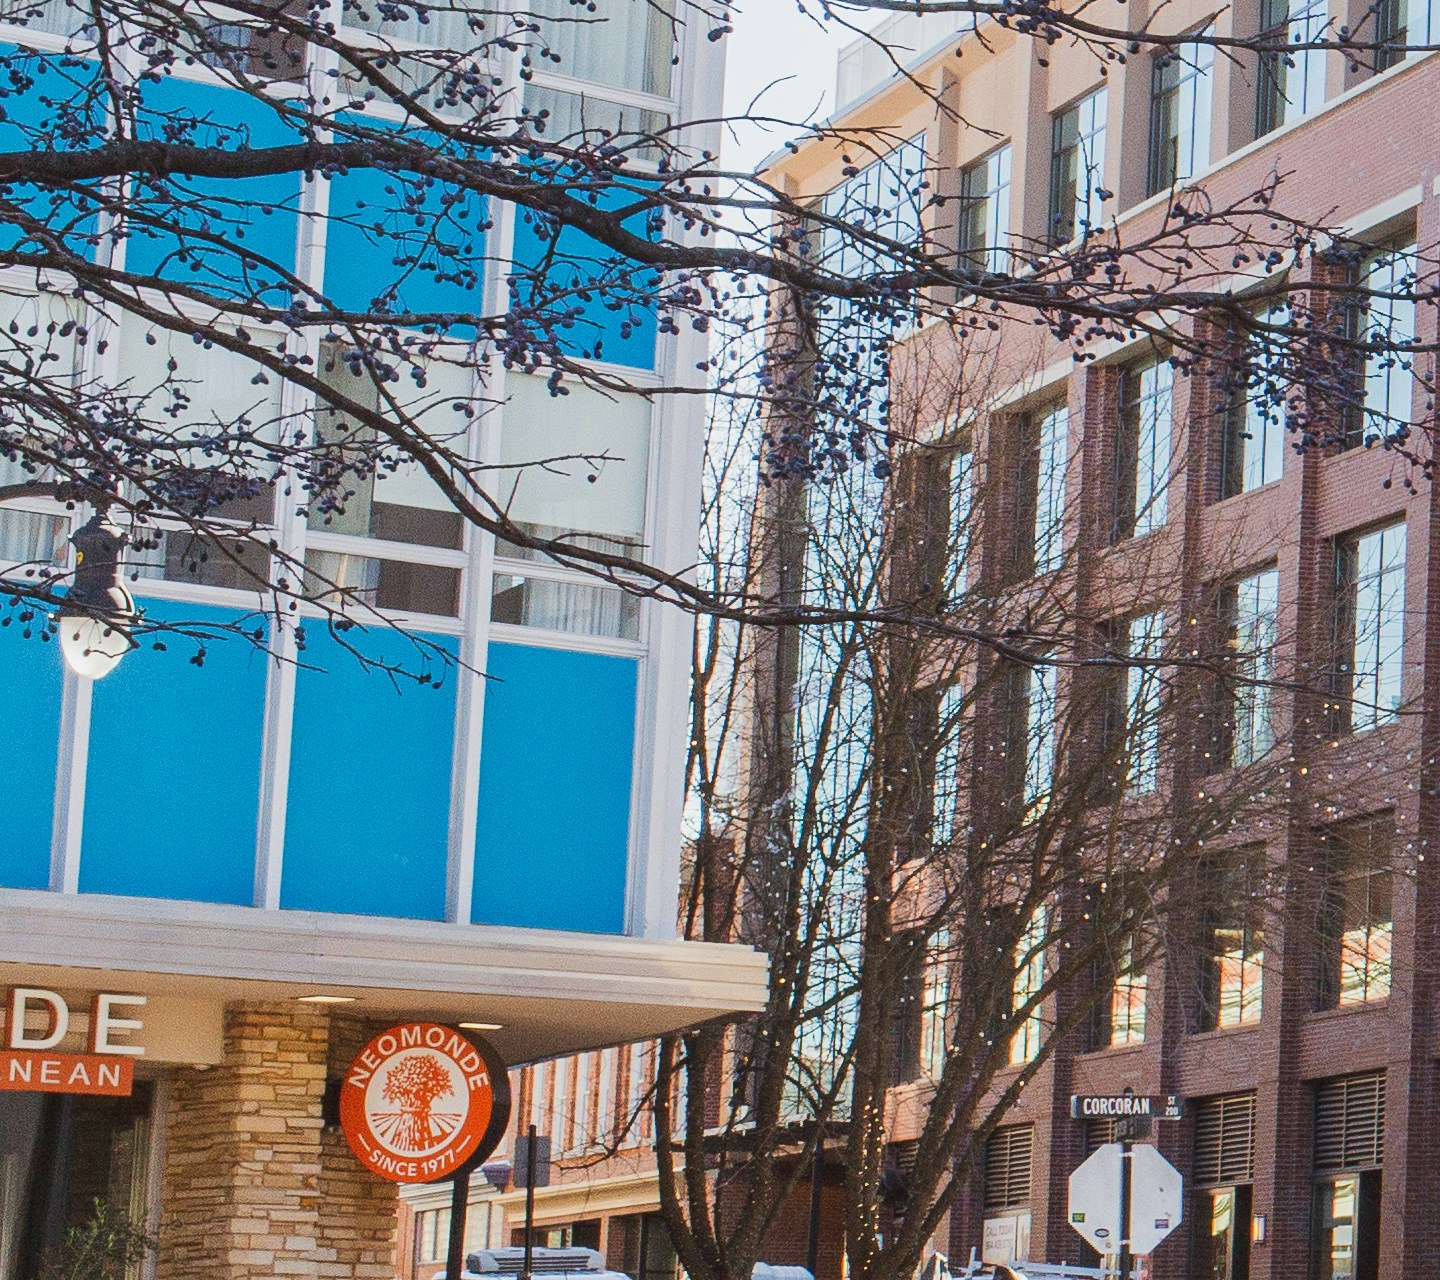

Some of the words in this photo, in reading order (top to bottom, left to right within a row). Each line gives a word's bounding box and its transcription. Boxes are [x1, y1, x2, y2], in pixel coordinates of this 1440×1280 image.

[8, 987, 148, 1056] DE
[349, 1025, 489, 1091] NEOMONDE
[9, 1058, 120, 1087] NEAN
[1083, 1097, 1150, 1115] CORCORAN
[1167, 1095, 1176, 1105] ST
[1165, 1106, 1179, 1116] 200
[369, 1149, 417, 1176] SINCE
[421, 1149, 455, 1175] 1977
